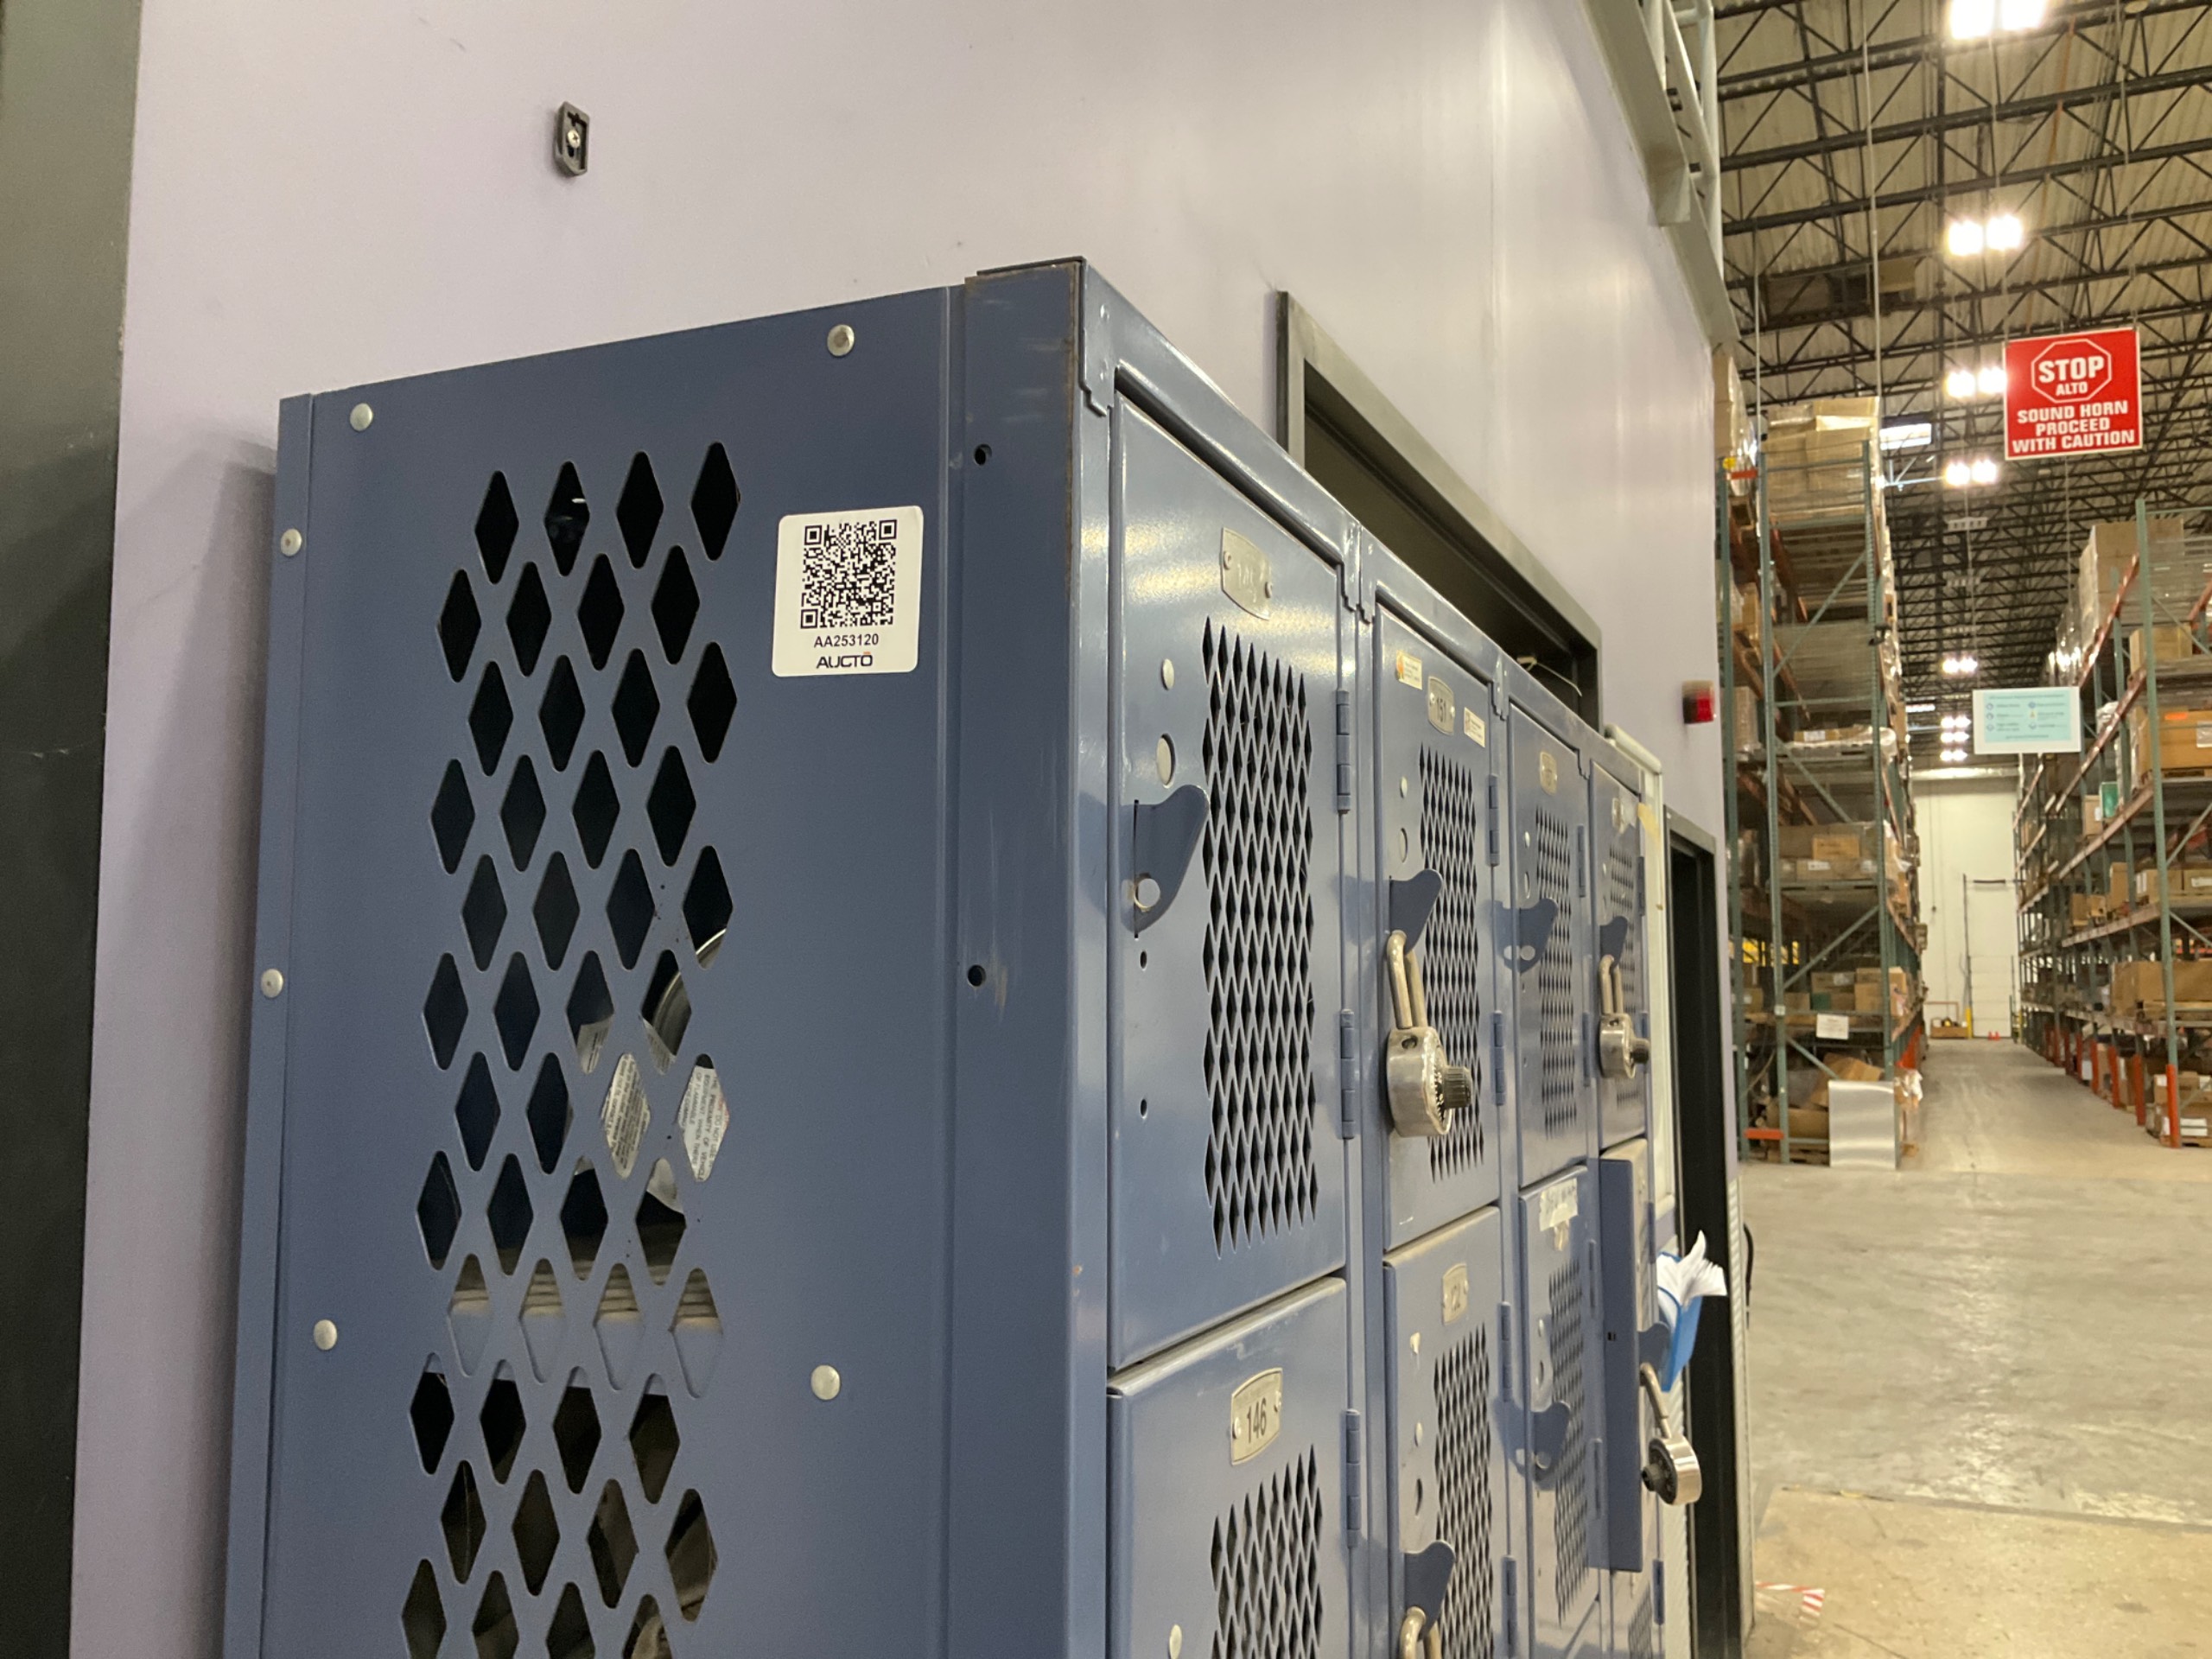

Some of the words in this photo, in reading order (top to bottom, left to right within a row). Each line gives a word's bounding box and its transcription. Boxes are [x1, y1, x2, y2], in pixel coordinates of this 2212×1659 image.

[2038, 356, 2104, 383] STOP
[2056, 382, 2088, 397] ALTO
[2018, 405, 2075, 423] SOUND
[2080, 400, 2128, 417] HORN
[2036, 417, 2110, 435] PROCEED
[2012, 437, 2056, 454] WITH
[2062, 430, 2134, 449] CAUTION
[813, 632, 880, 648] AA253120
[816, 651, 874, 669] AUCTO
[700, 1075, 710, 1115] EQUIPMENT
[705, 1094, 715, 1132] PROXIMITY
[715, 1115, 721, 1126] DO
[695, 1119, 703, 1140] WHEN
[703, 1137, 709, 1147] OF
[1247, 1396, 1267, 1444] 146
